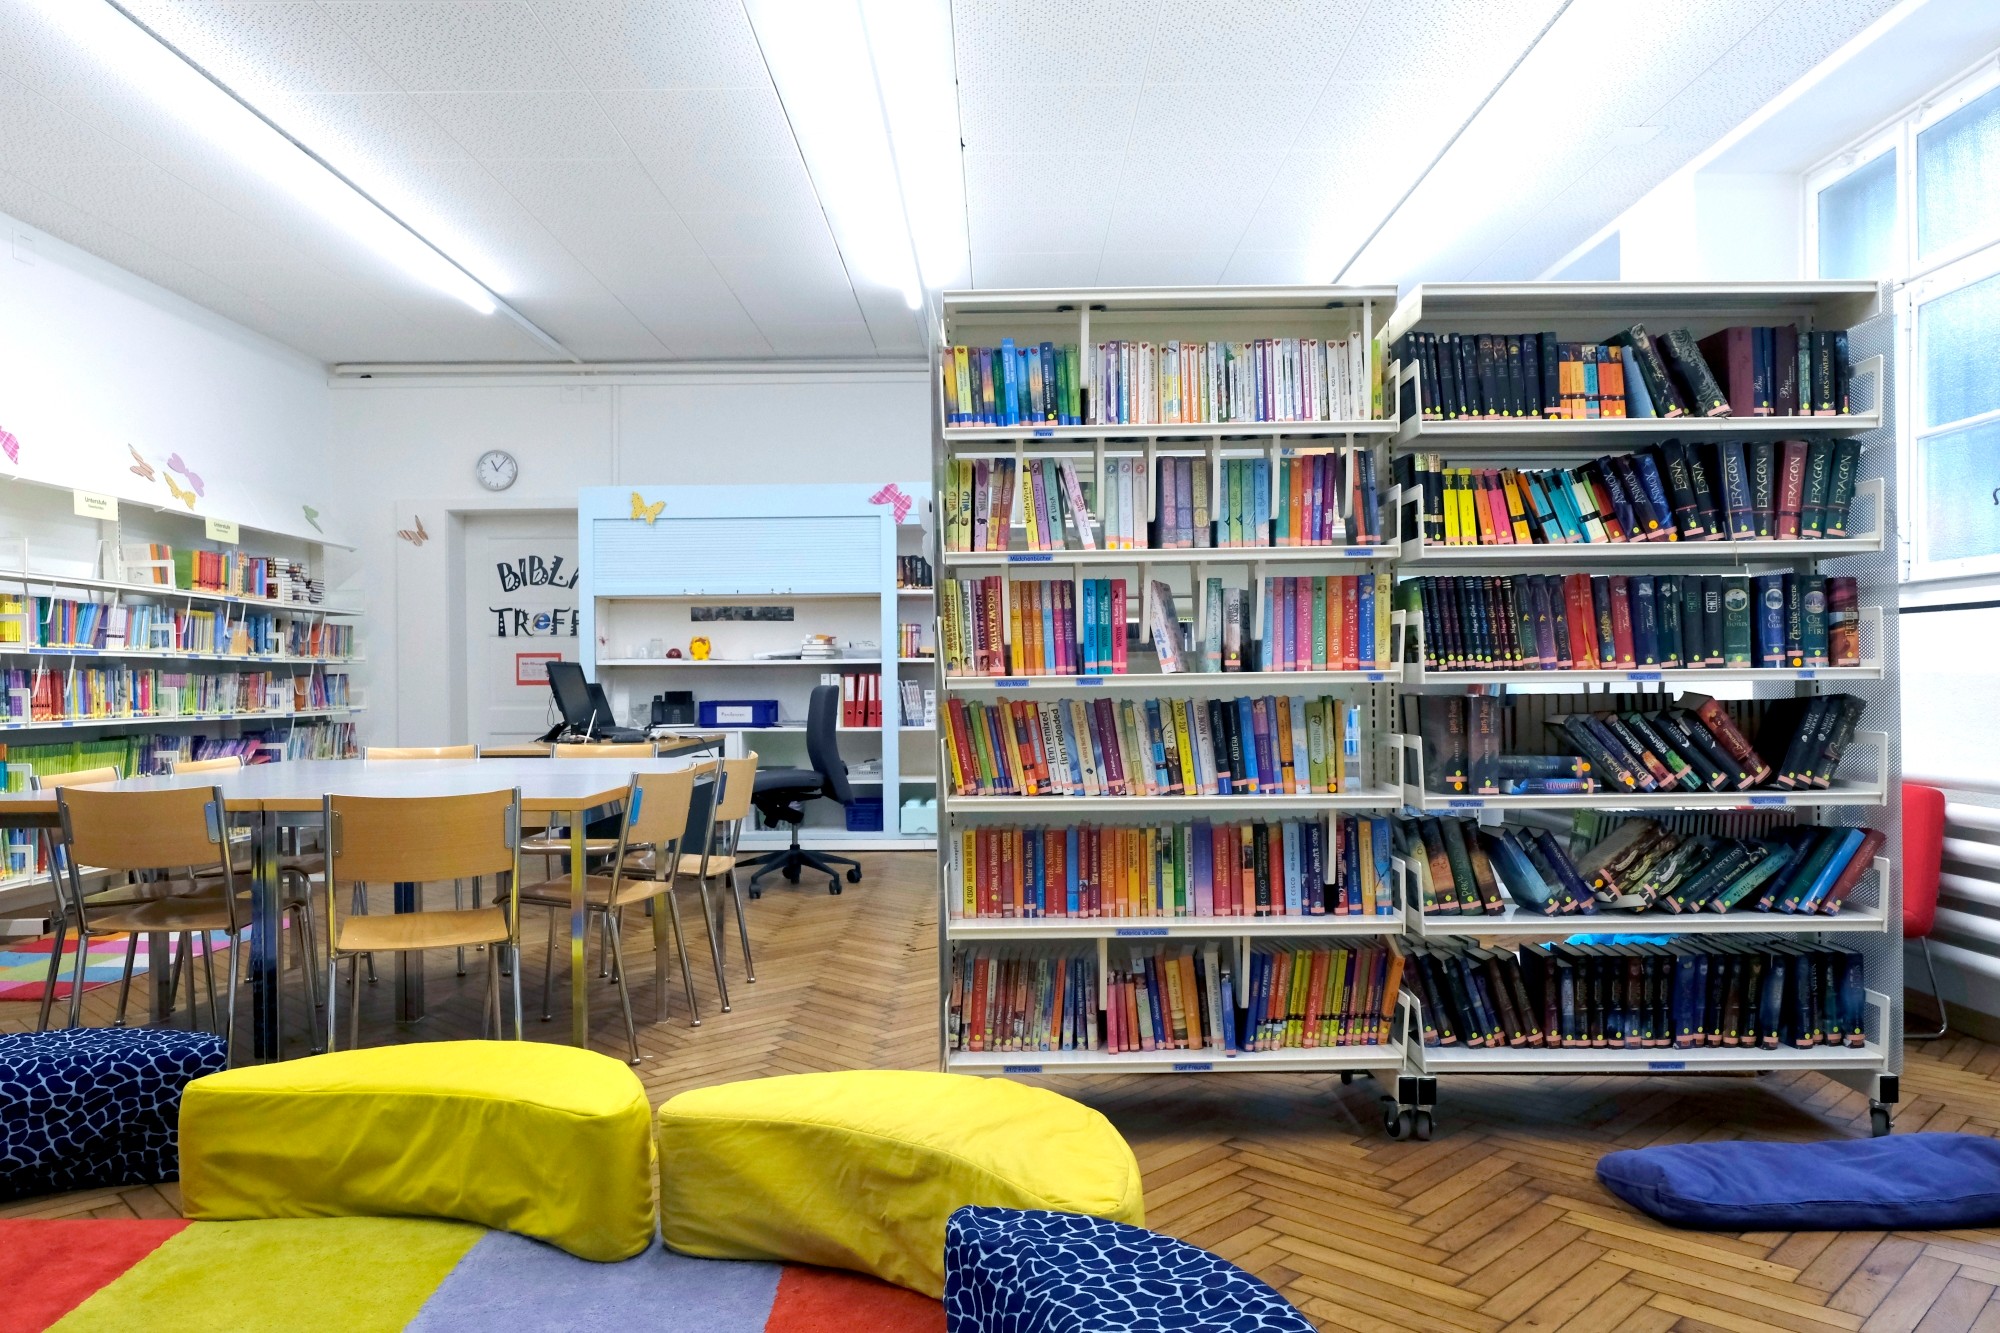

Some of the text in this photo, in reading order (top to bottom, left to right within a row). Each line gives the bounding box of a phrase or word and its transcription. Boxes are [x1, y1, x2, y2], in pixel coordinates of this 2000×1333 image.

[1604, 472, 1626, 504] ANIMOX
[1624, 471, 1646, 504] ANIMOX
[1645, 471, 1665, 505] ANIMOX
[1670, 459, 1687, 491] EONA
[1693, 462, 1710, 494] EONA
[1727, 456, 1743, 507] ERAGON
[1757, 457, 1767, 508] ERAGON
[1788, 457, 1800, 507] ERAGON
[1811, 454, 1824, 504] ERAGON
[1836, 454, 1852, 504] ERAGON
[962, 491, 970, 512] WILD
[1707, 592, 1717, 612] GONE
[988, 589, 998, 652] MOLLY MOON
[1789, 613, 1801, 640] Archie
[945, 624, 954, 651] MOLLY
[1052, 708, 1066, 745] reloaded
[1480, 701, 1490, 734] Harry Potter
[1040, 712, 1056, 764] finn remixed
[1716, 847, 1744, 869] RECKLESS
